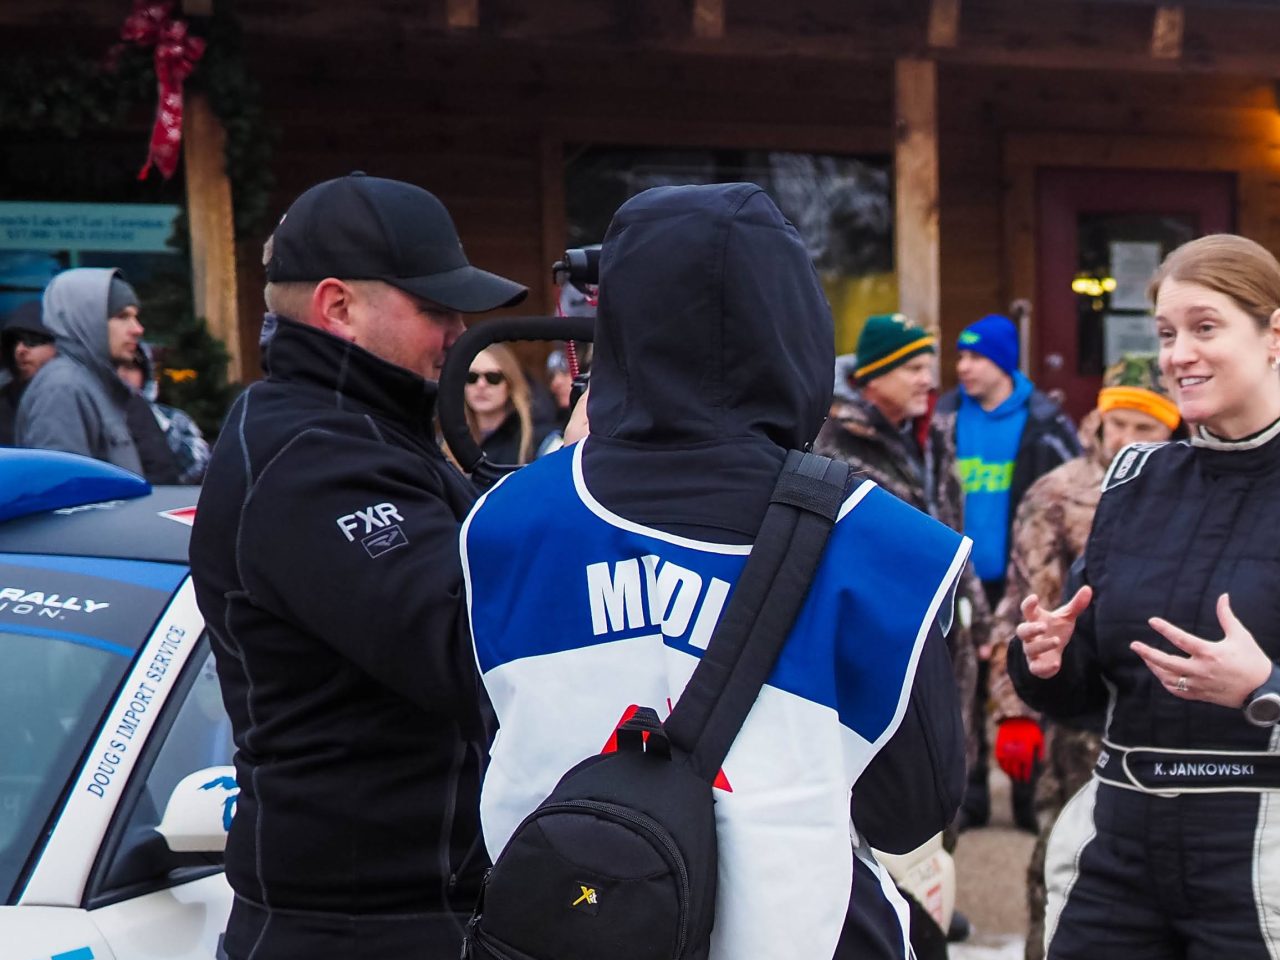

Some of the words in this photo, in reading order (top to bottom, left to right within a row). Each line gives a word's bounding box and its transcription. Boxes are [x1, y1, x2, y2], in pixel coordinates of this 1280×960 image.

[336, 502, 405, 542] FXR
[0, 587, 110, 613] RALLY
[116, 682, 156, 744] IMPORT
[147, 624, 186, 683] SERVICE
[1154, 762, 1167, 776] K.
[1169, 762, 1254, 777] JANKOWSKI
